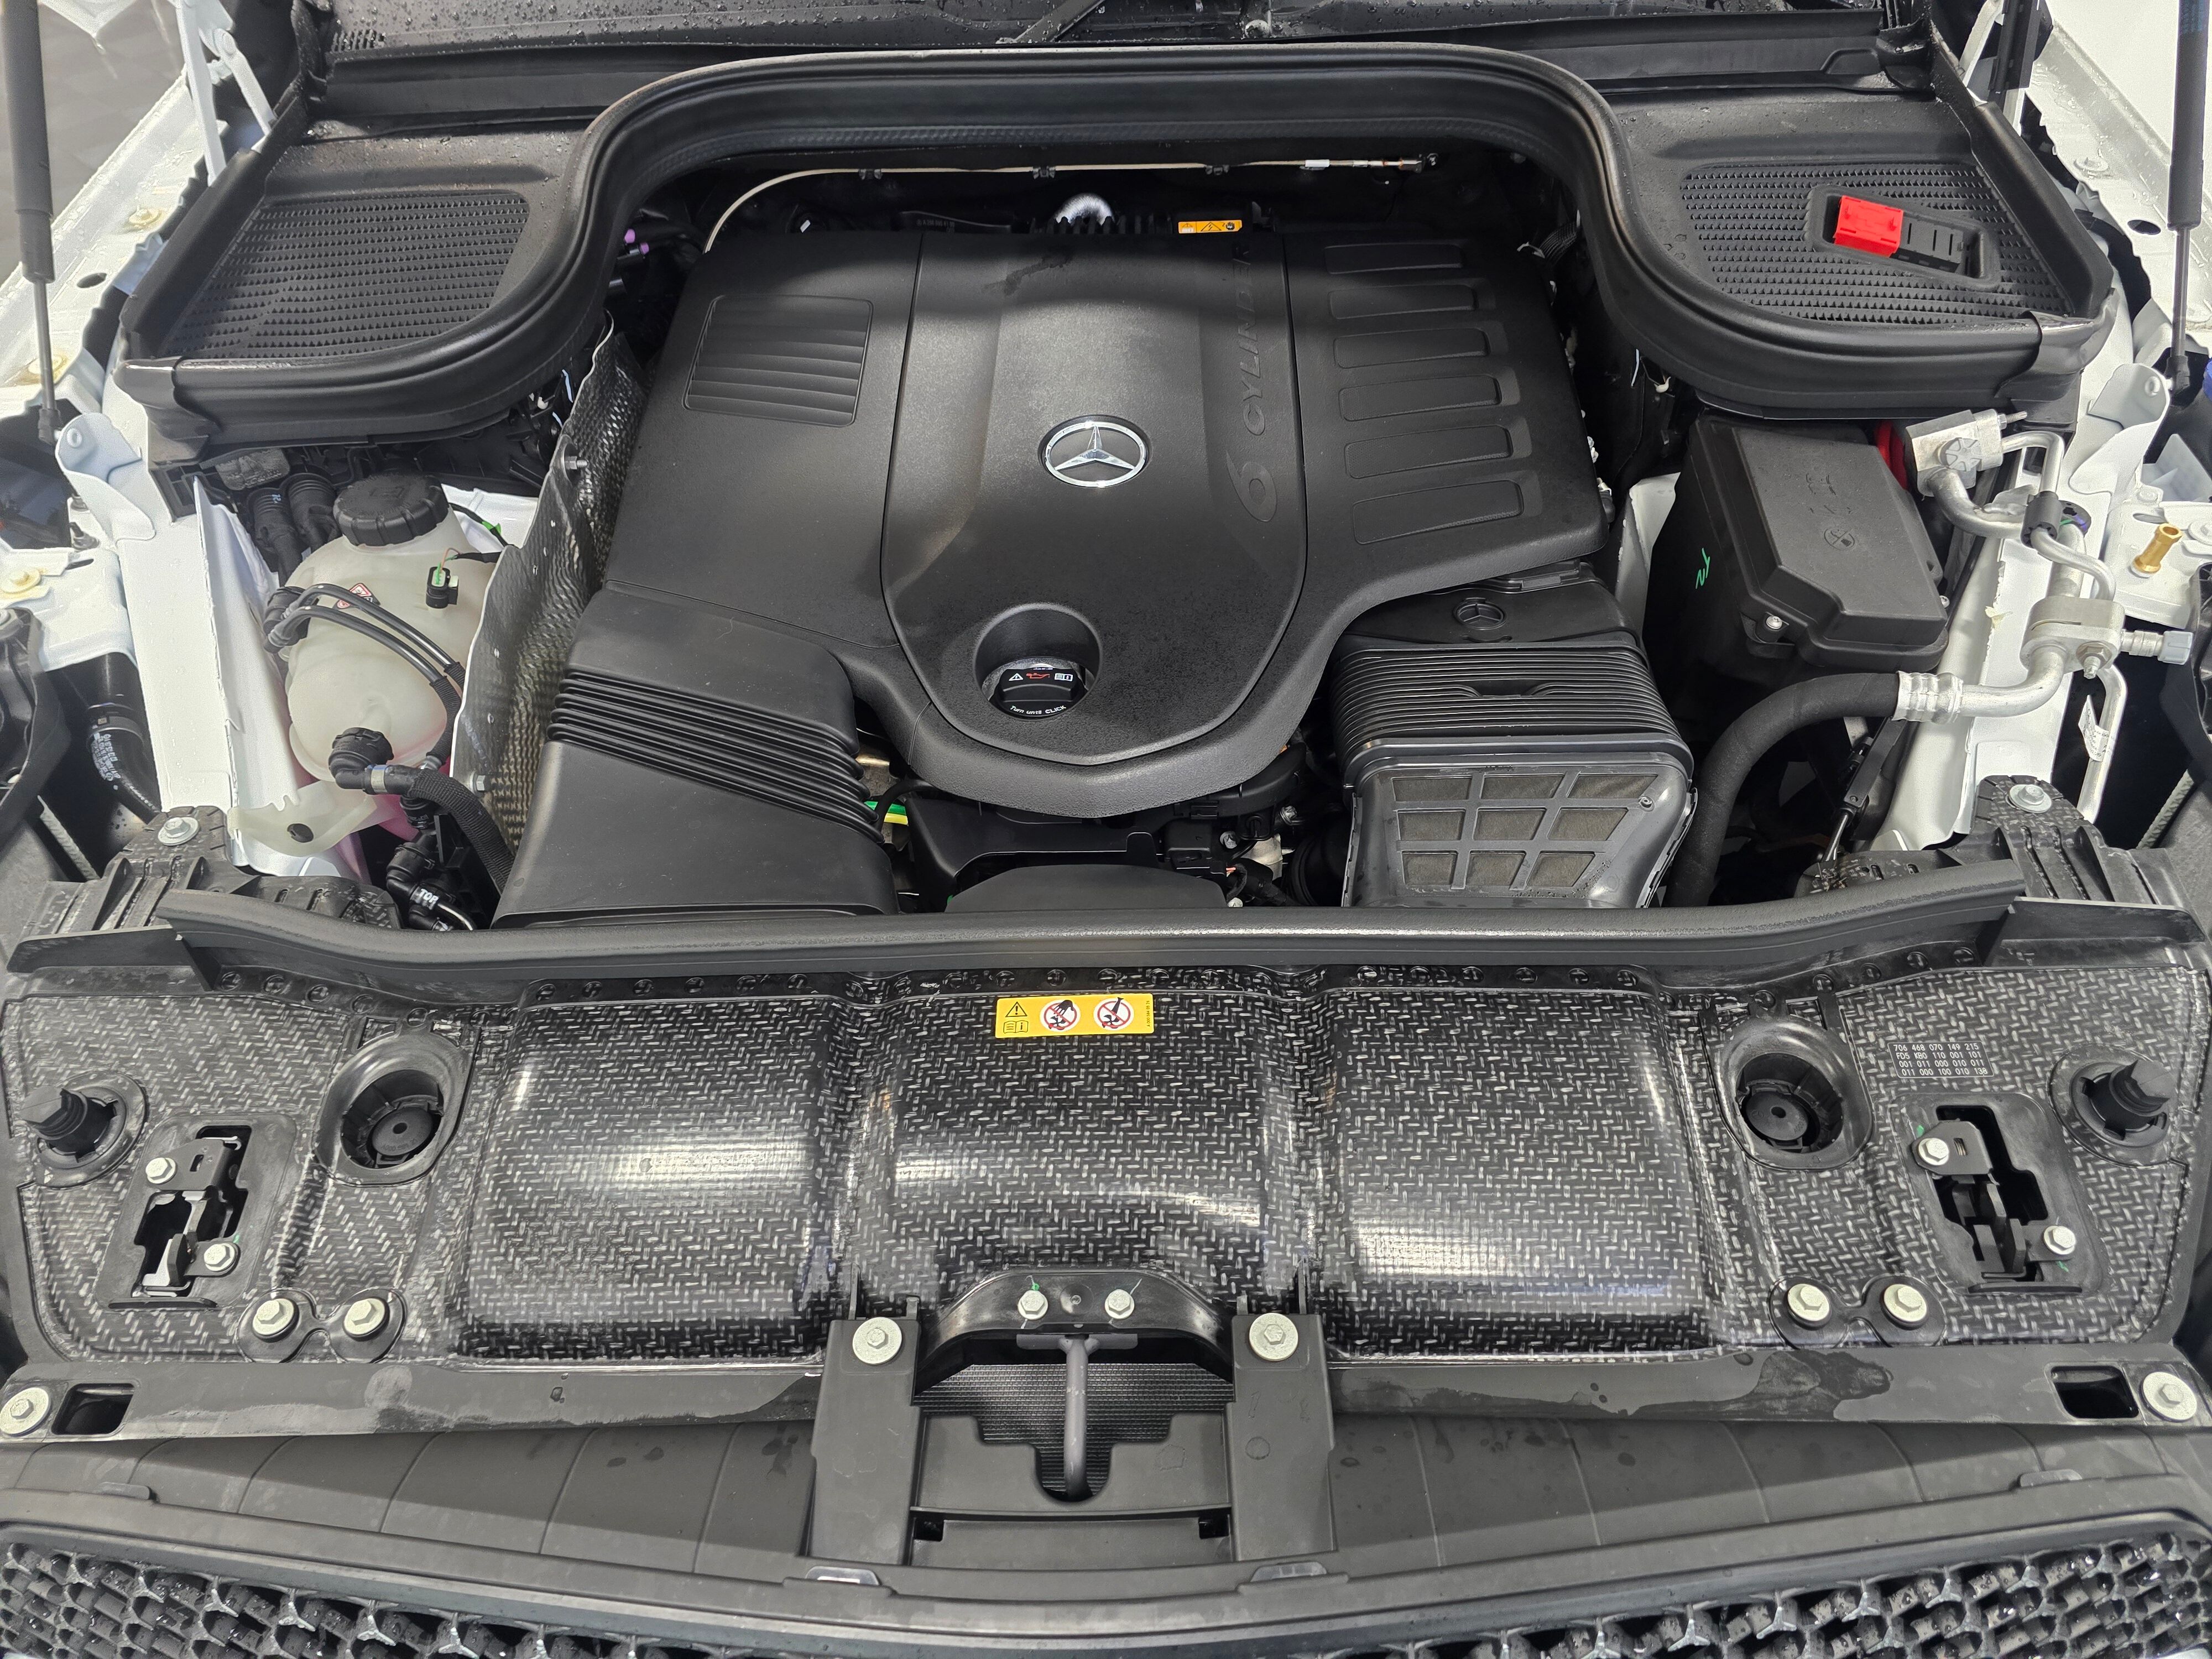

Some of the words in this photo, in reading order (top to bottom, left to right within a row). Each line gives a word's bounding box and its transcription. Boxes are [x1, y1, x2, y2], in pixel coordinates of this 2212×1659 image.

[1232, 243, 1266, 437] CYLINDER
[1226, 450, 1278, 523] 6
[1010, 705, 1025, 713] Turn
[1045, 705, 1067, 714] CLICK
[419, 889, 439, 902] TOP
[1964, 1042, 1979, 1051] 215
